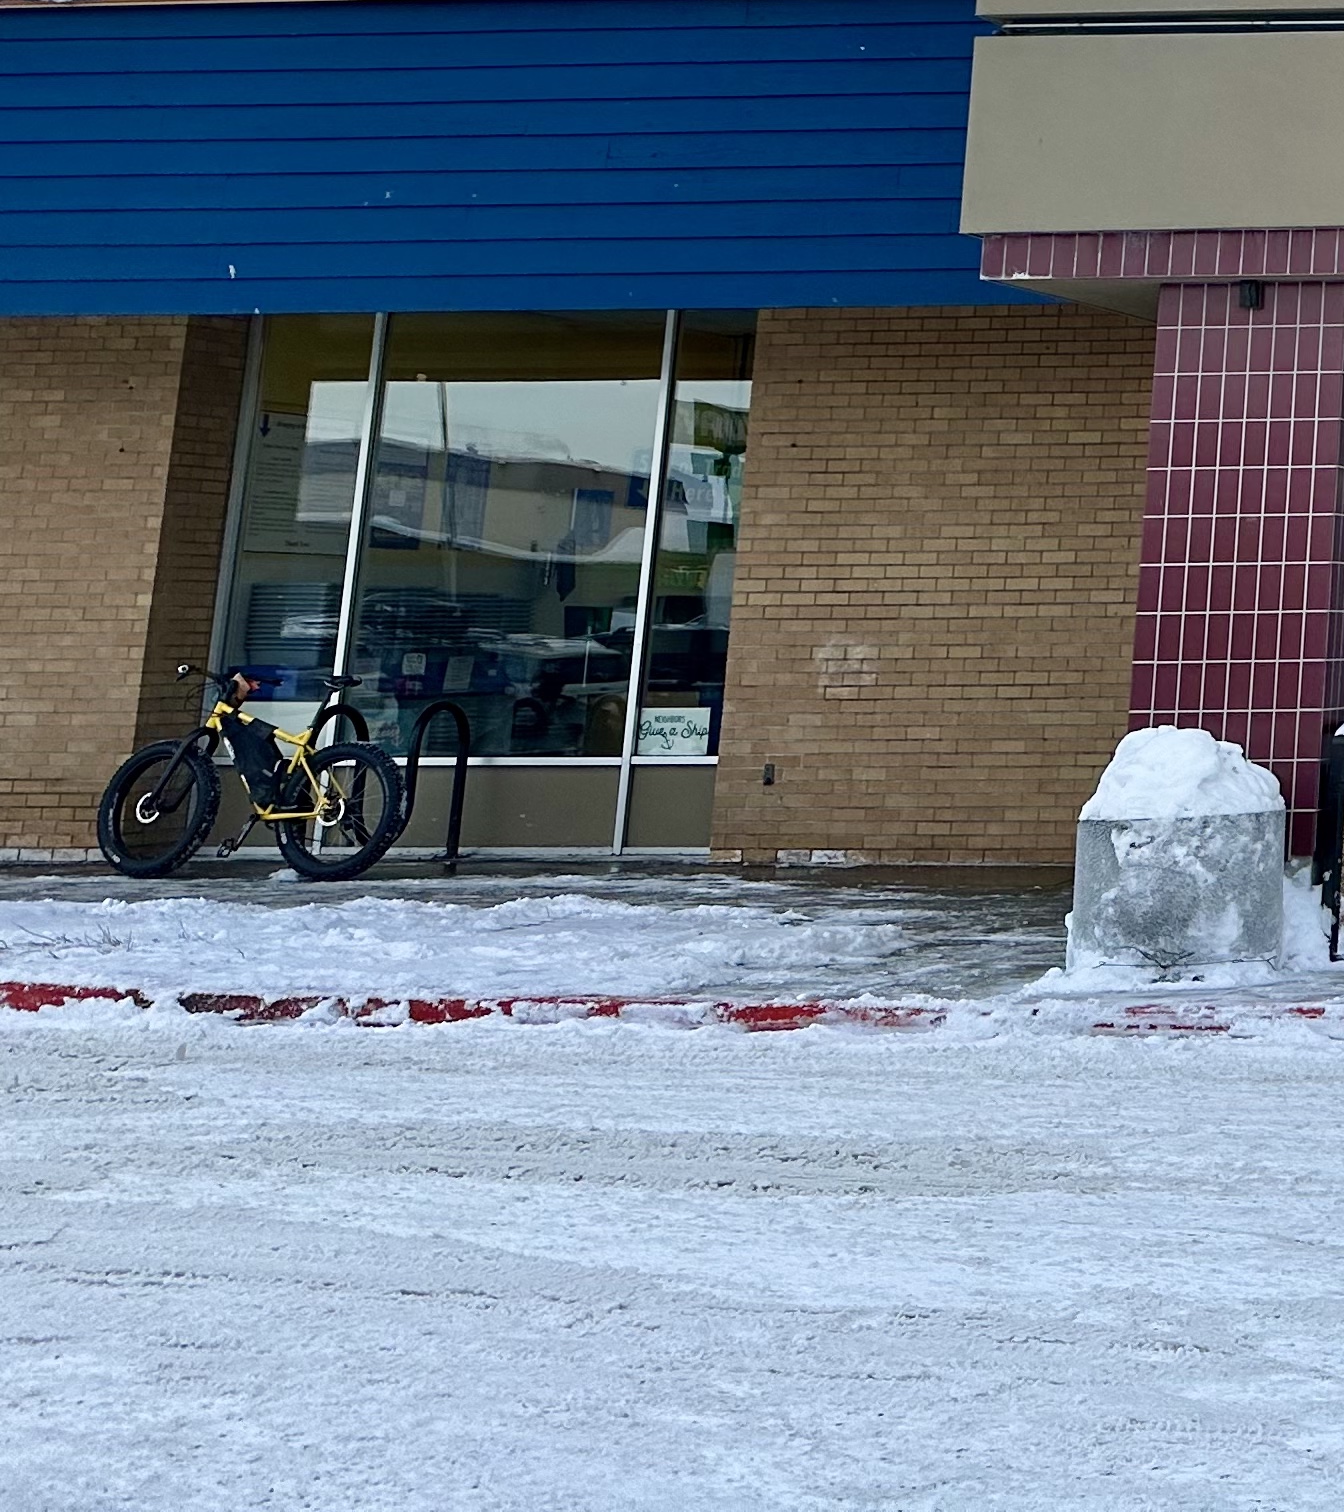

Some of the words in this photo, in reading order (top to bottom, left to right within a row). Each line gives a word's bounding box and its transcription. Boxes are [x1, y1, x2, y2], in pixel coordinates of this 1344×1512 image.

[638, 720, 667, 740] Give
[668, 727, 679, 736] a
[680, 720, 709, 740] Ship
